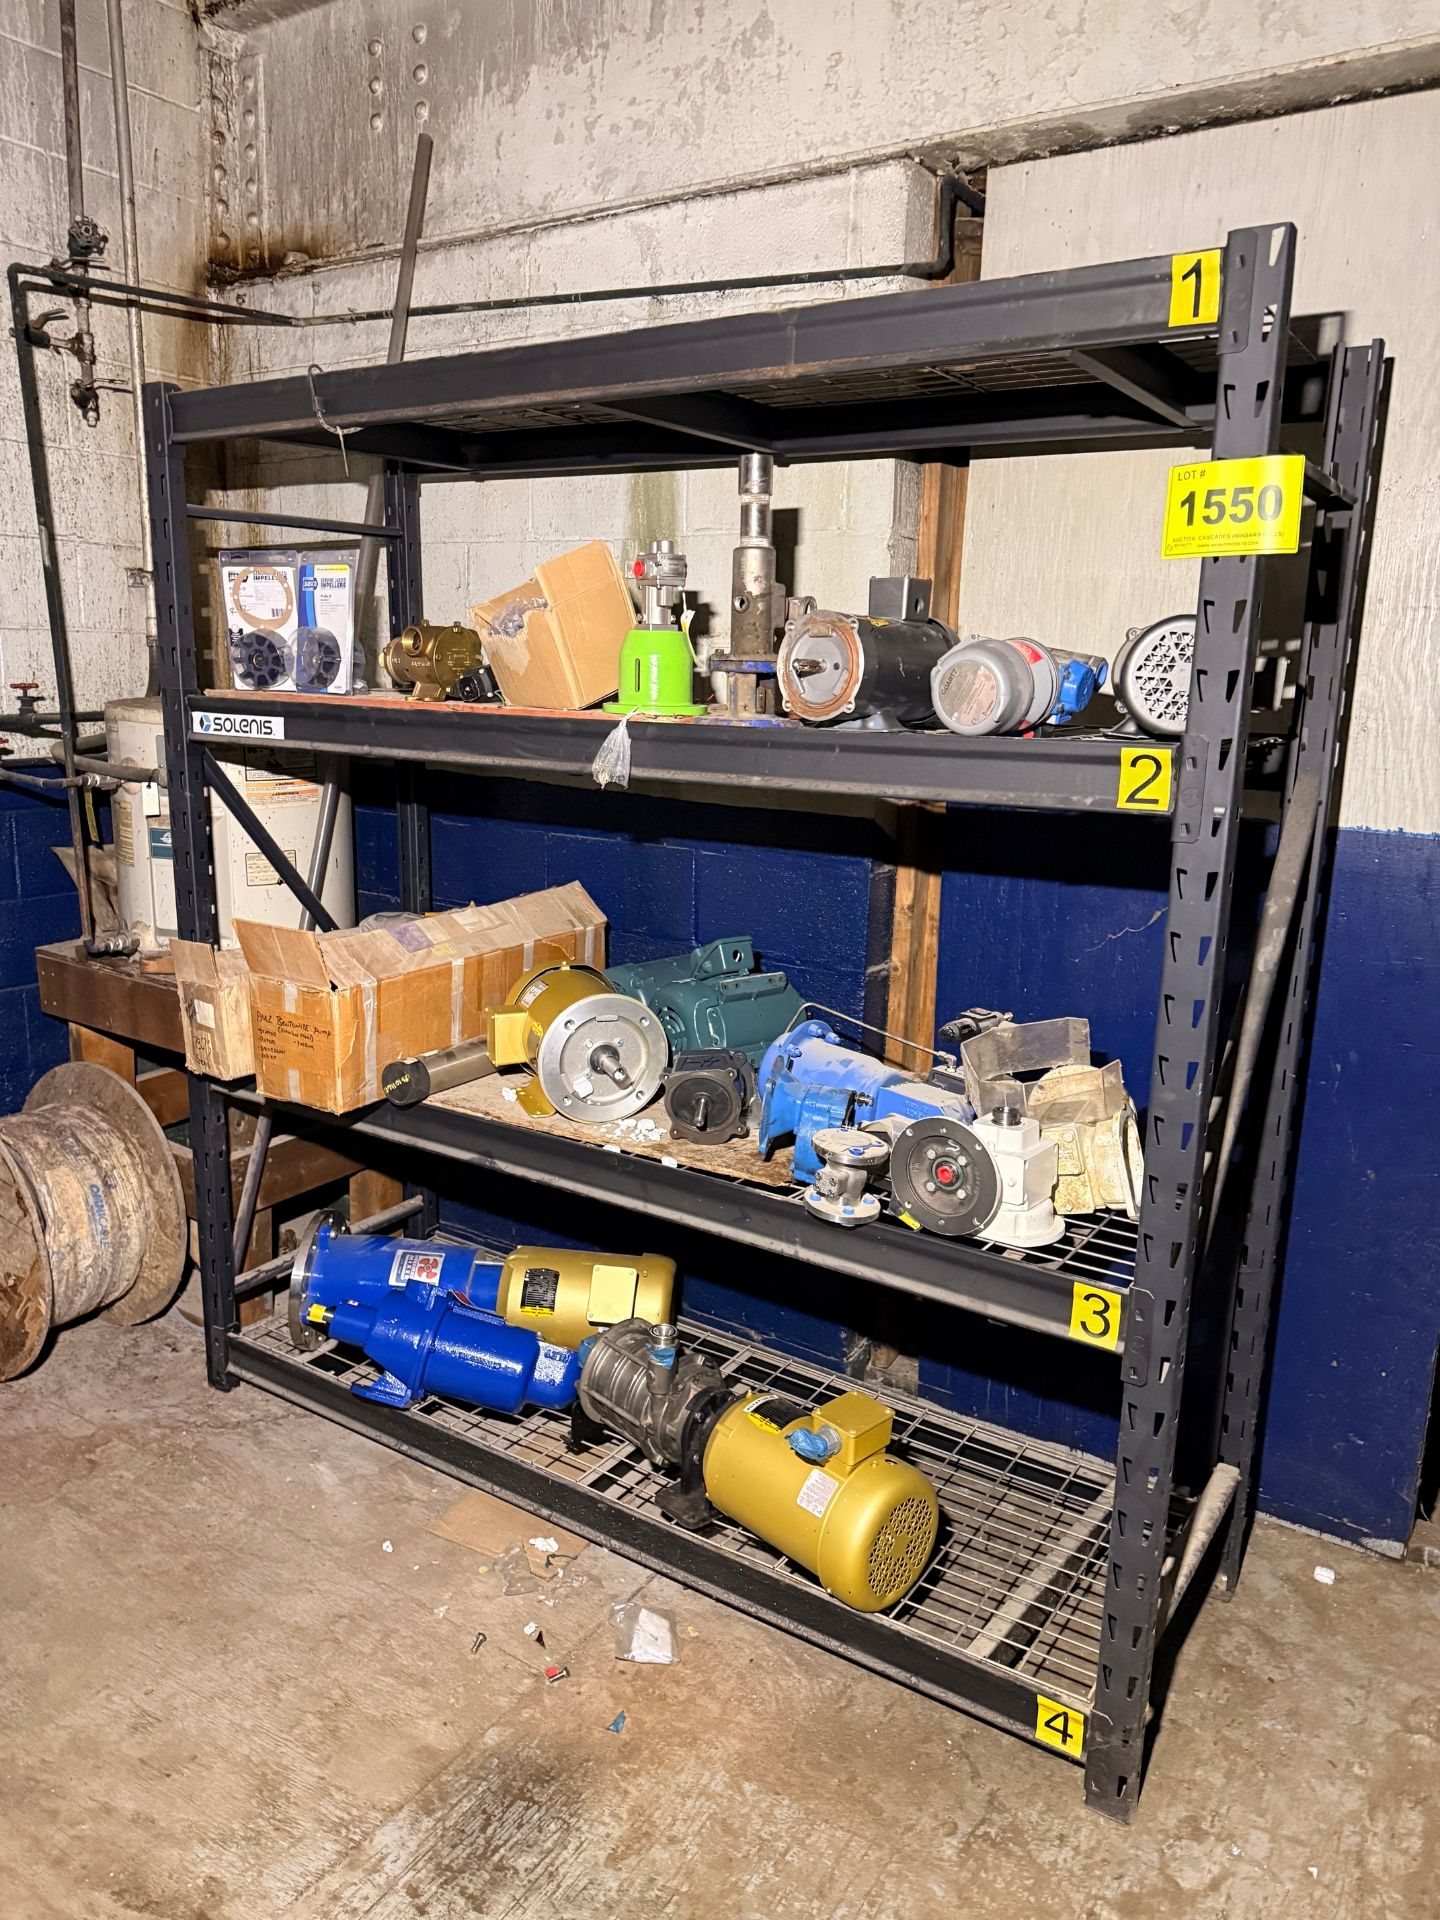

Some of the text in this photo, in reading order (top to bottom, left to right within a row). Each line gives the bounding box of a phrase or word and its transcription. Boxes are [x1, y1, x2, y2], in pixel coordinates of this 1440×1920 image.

[1182, 258, 1202, 318] 1
[1178, 469, 1206, 481] LOT #
[1180, 485, 1283, 527] 1550
[1125, 754, 1162, 804] 2
[1080, 1293, 1111, 1339] 3
[1044, 1711, 1074, 1746] 4
